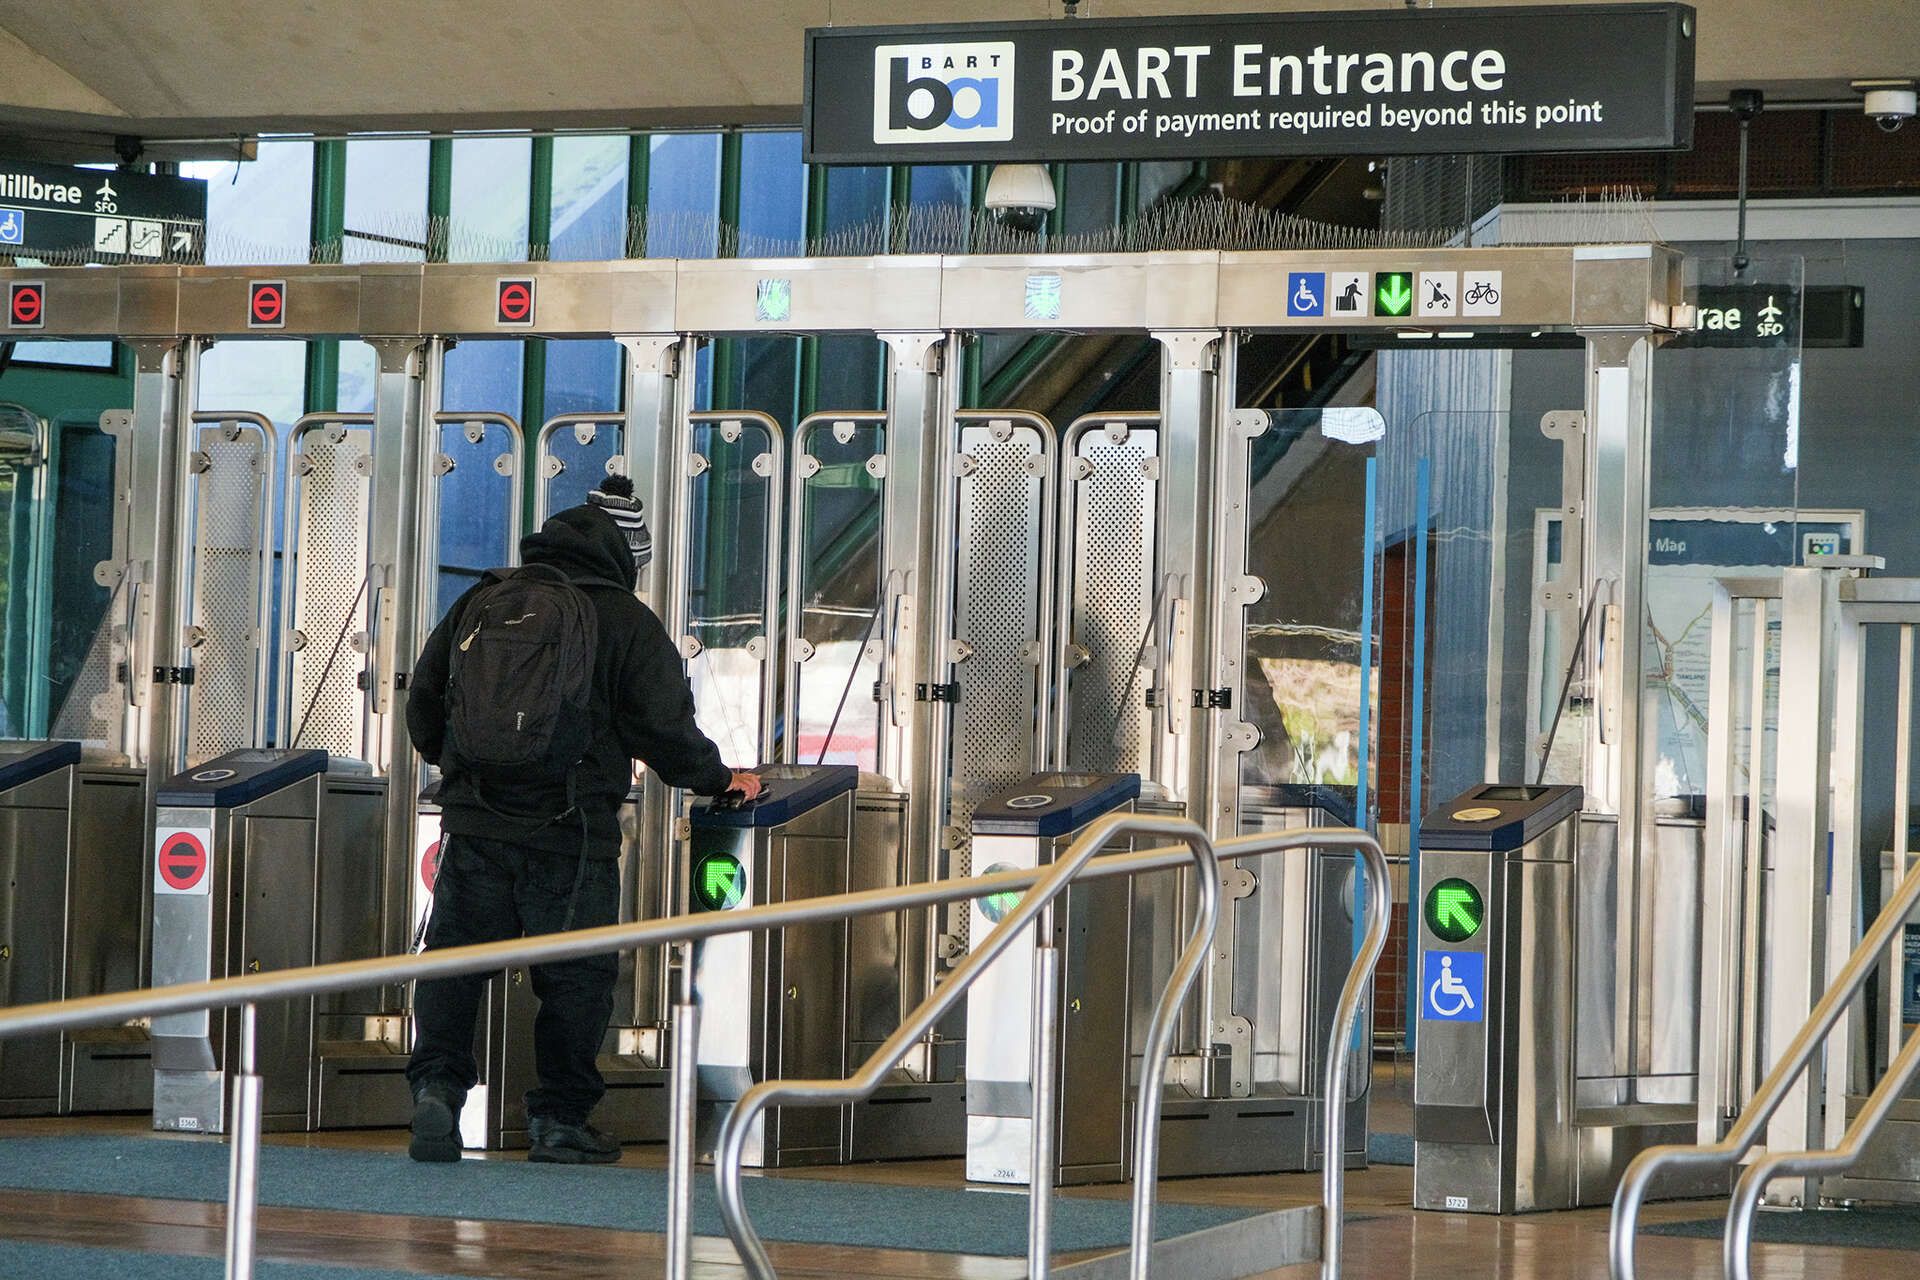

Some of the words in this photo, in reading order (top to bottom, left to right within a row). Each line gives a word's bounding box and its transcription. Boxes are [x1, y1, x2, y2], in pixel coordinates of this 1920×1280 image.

[921, 55, 1001, 69] BART
[1051, 46, 1211, 101] BART
[1233, 44, 1507, 97] Entrance
[1052, 110, 1116, 135] Proof
[1122, 109, 1149, 133] of
[1156, 107, 1261, 138] payment
[1270, 103, 1372, 134] required
[1381, 101, 1473, 132] beyond
[1481, 100, 1527, 125] this
[1536, 99, 1603, 129] point
[94, 201, 118, 214] SFO
[1757, 323, 1784, 337] SFO
[1655, 537, 1687, 555] Map
